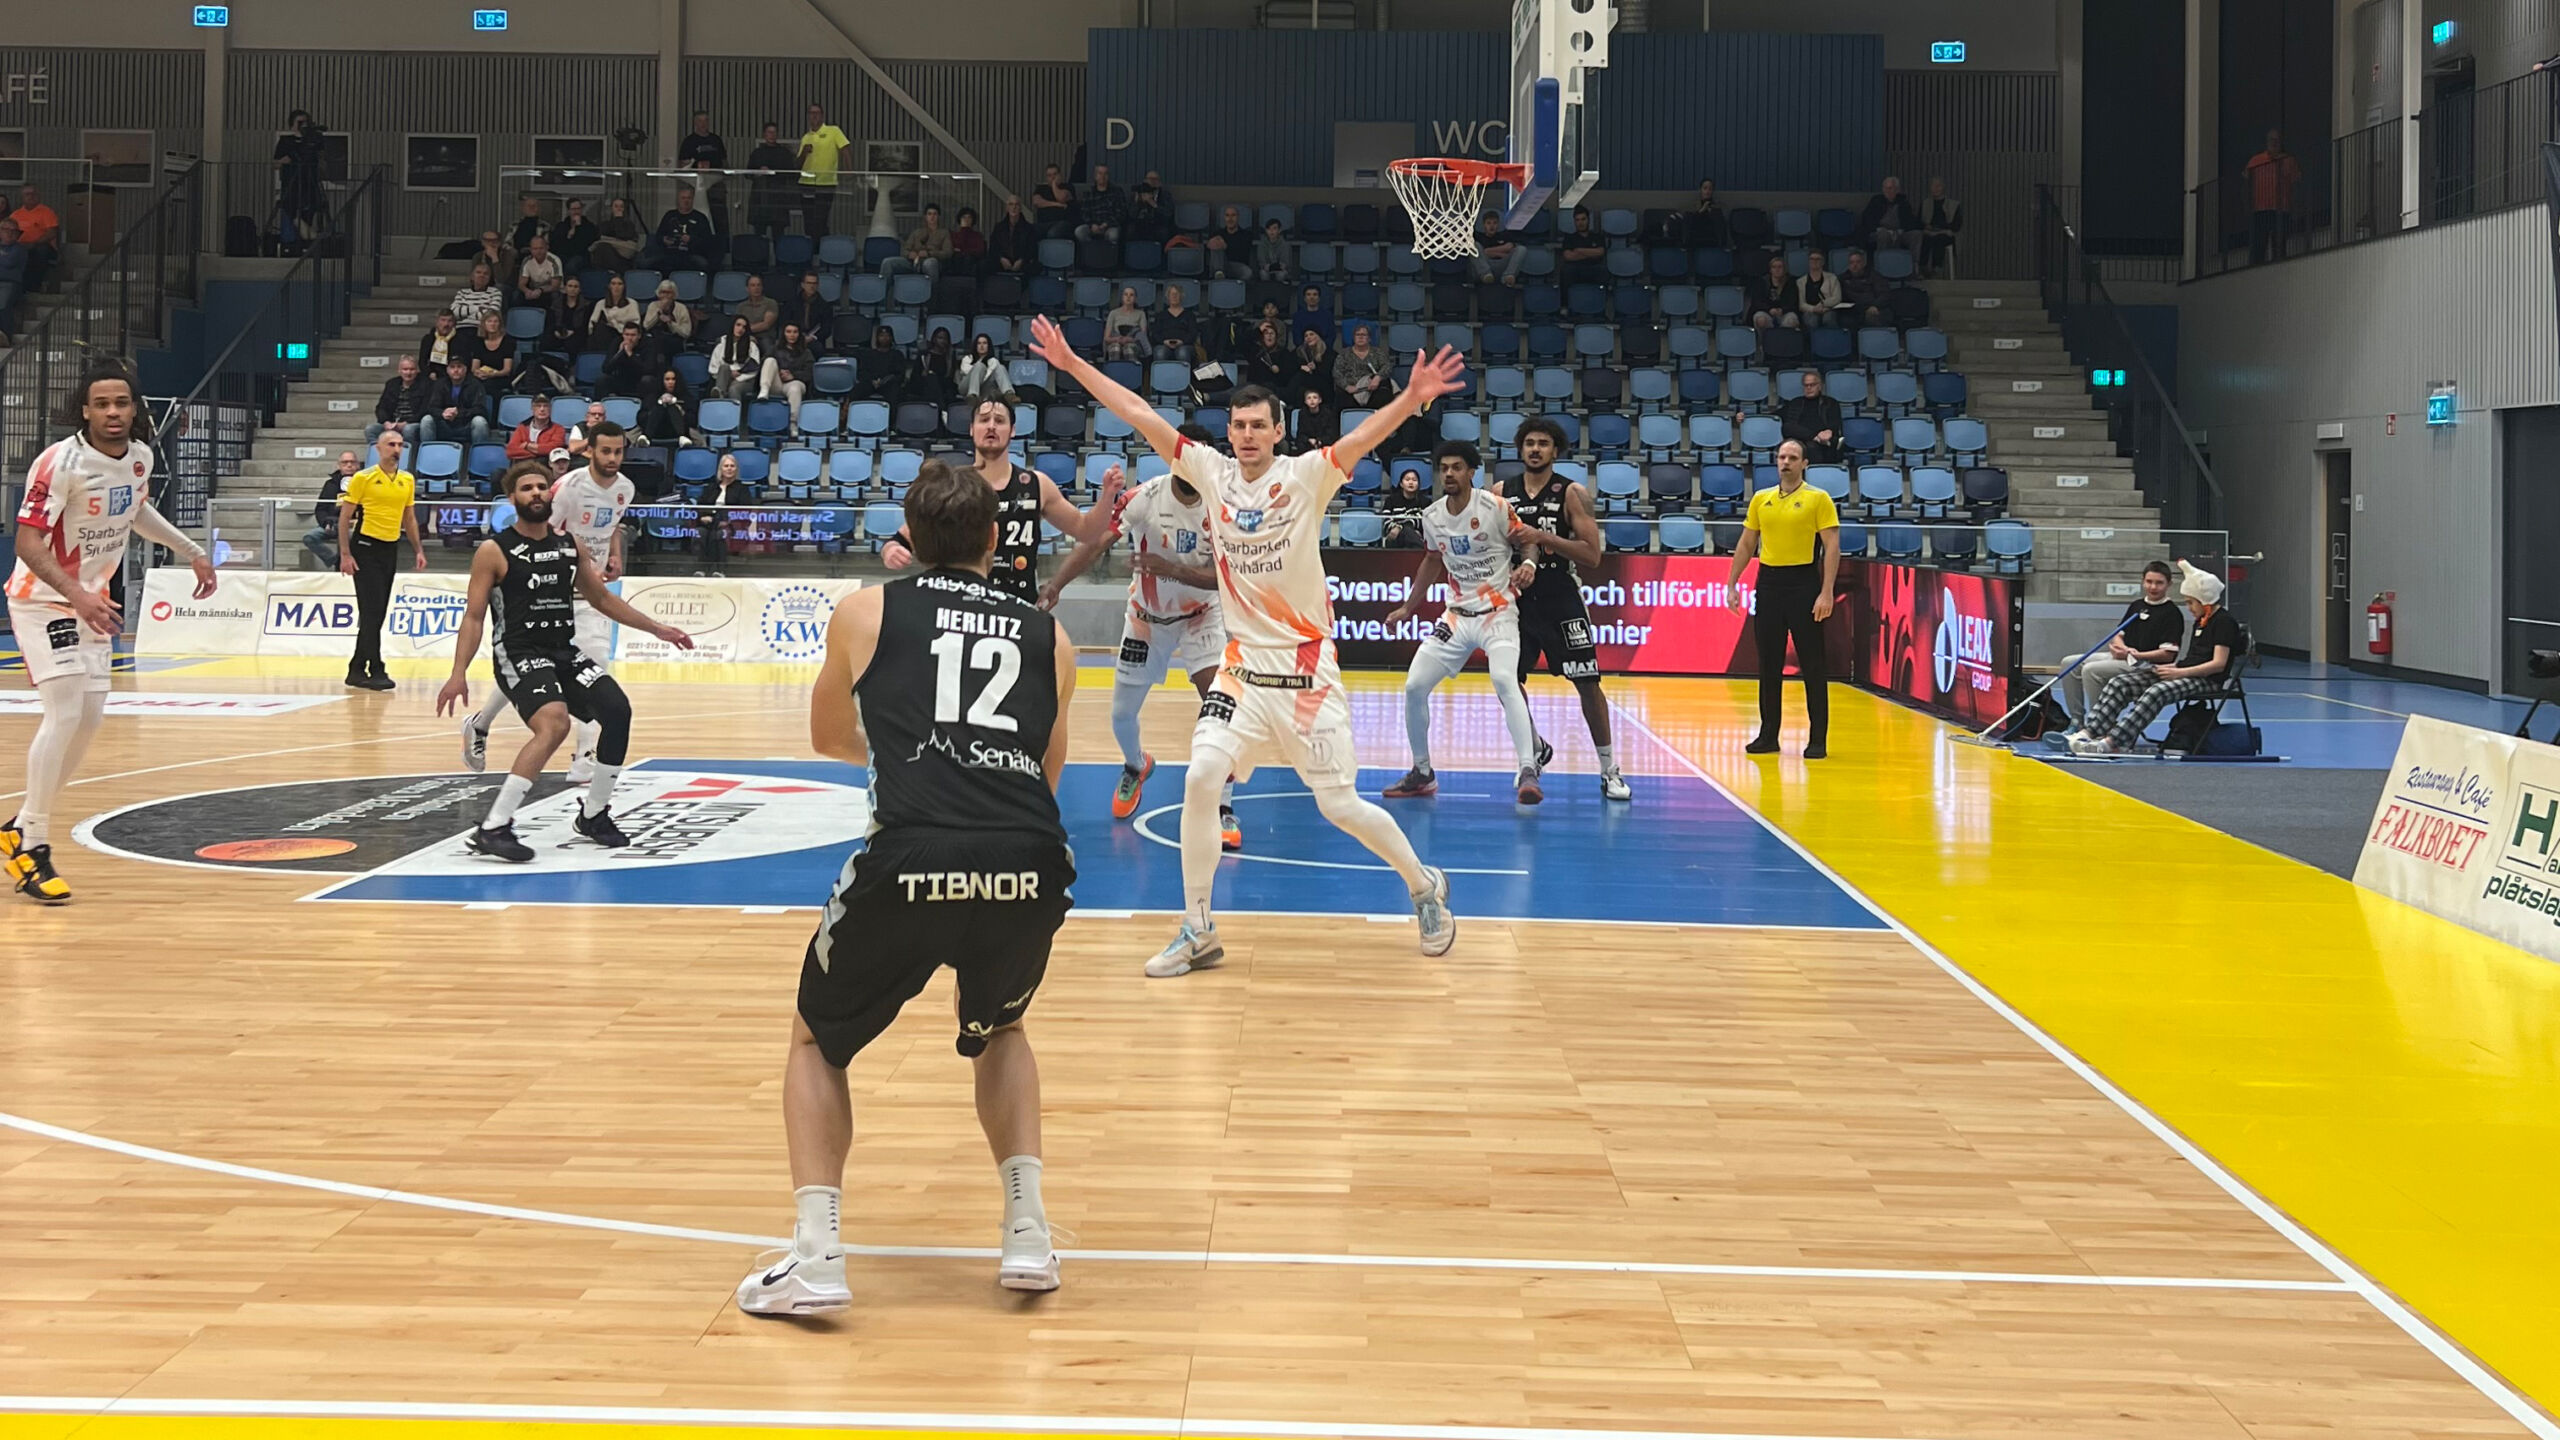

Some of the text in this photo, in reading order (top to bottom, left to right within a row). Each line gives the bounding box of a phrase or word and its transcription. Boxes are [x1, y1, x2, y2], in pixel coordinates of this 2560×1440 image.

[0, 65, 49, 104] FÉ
[1106, 118, 1135, 151] D
[1432, 120, 1508, 156] WC
[87, 497, 103, 517] 5
[581, 511, 591, 525] 9
[1005, 520, 1035, 547] 24
[1537, 516, 1558, 536] 35
[1161, 533, 1169, 549] 1
[569, 564, 577, 585] 7
[394, 593, 468, 606] Kondito
[1579, 580, 1626, 607] och
[174, 606, 253, 620] Hela människan
[274, 602, 359, 629] MAB
[389, 606, 466, 638] BIVU
[653, 602, 709, 615] GILLET
[524, 620, 574, 629] VOLV
[773, 620, 827, 643] KW
[935, 607, 1022, 640] HERLITZ
[1330, 614, 1444, 641] utveckla
[1591, 618, 1652, 645] nnier
[1957, 613, 1994, 665] LEAX
[929, 631, 1022, 733] 12
[2460, 773, 2494, 814] Café
[608, 801, 767, 860] MITSUBISHI
[2371, 804, 2488, 873] FALKBOET
[897, 870, 1040, 903] TIBNOR
